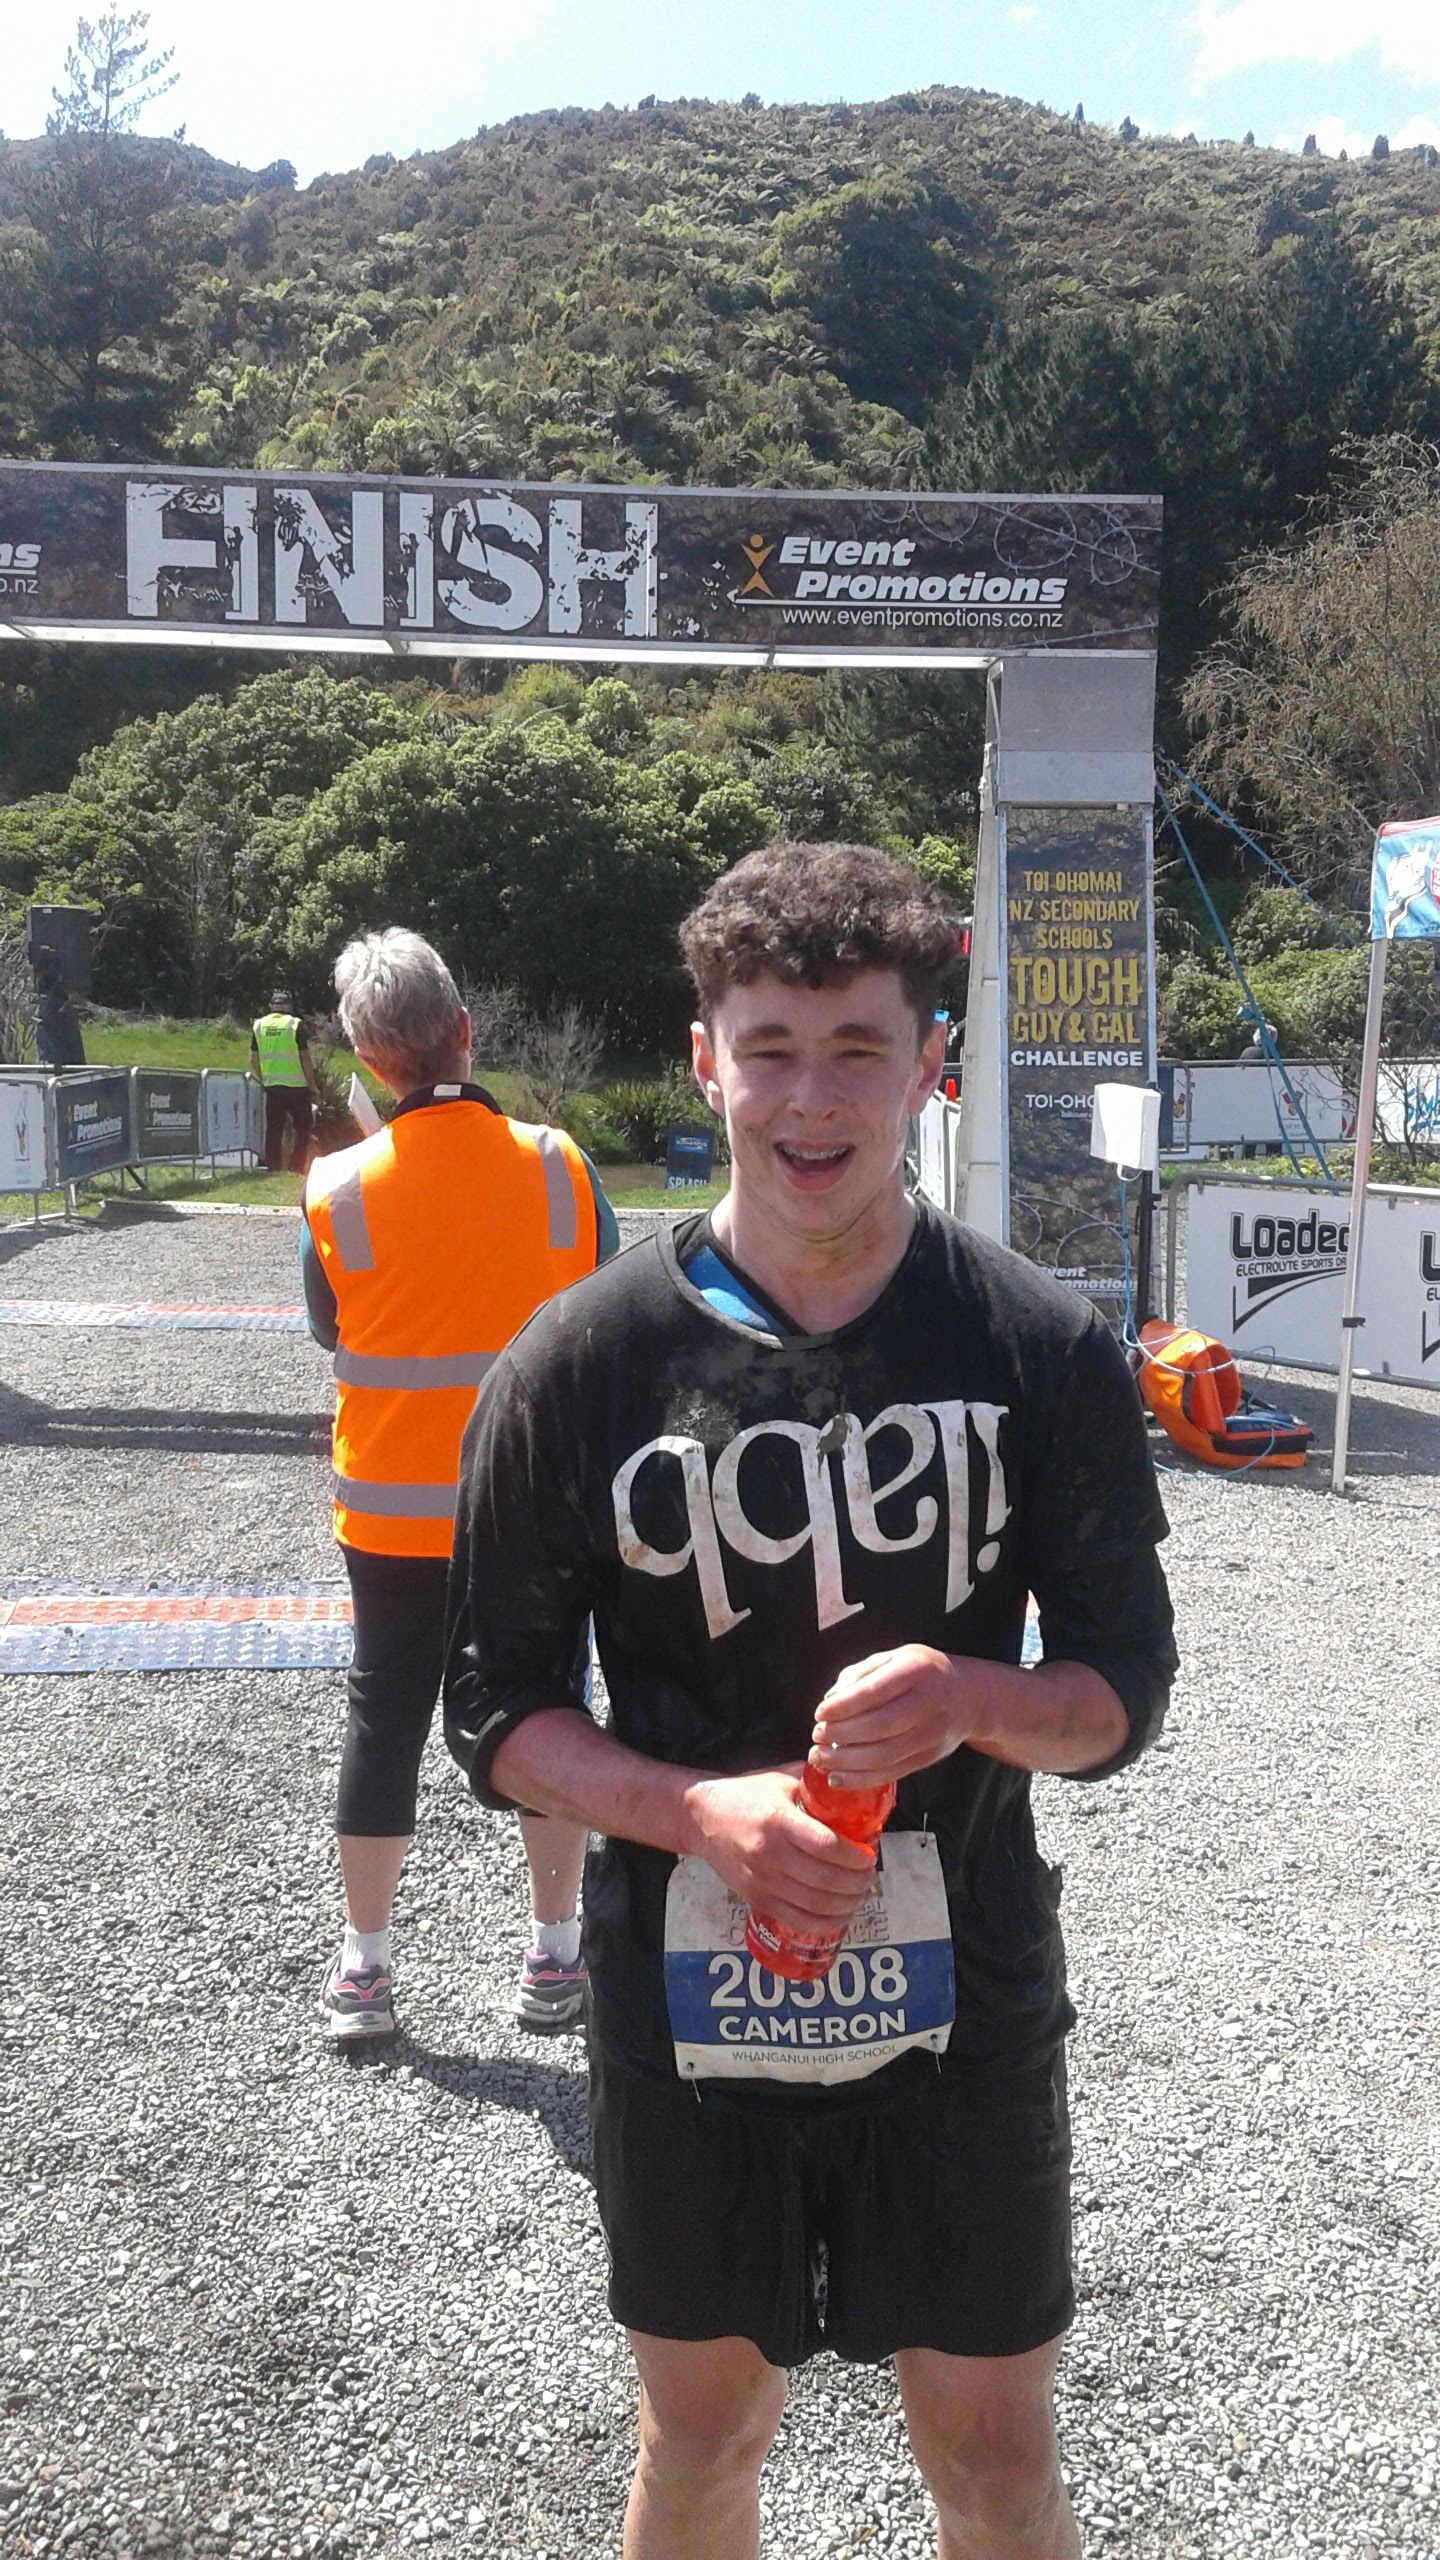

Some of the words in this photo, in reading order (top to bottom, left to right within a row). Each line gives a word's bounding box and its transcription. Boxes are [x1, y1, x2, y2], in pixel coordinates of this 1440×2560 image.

[126, 481, 658, 637] FINISH
[779, 535, 916, 566] Event
[795, 571, 1068, 602] Promotions
[782, 607, 1063, 629] www.eventpromotions.co.nz
[1023, 870, 1049, 892] TOI
[1055, 871, 1123, 893] OHOMAI
[1009, 899, 1034, 922] NZ
[1040, 899, 1140, 922] SECONDARY
[1037, 927, 1113, 950] SCHOOLS
[1011, 956, 1143, 1007] TOUGH
[1012, 1011, 1064, 1044] GUY
[1092, 1011, 1141, 1044] GAL
[1010, 1050, 1144, 1066] CHALLENGE
[1024, 1093, 1095, 1109] TOI-OHO
[1236, 1260, 1299, 1277] ELECTROLYTE
[1301, 1257, 1334, 1269] SPORTS
[708, 1947, 908, 2009] 20508
[719, 2008, 906, 2045] CAMERON
[732, 2050, 810, 2064] WHANGANUI
[812, 2053, 844, 2065] HIGH
